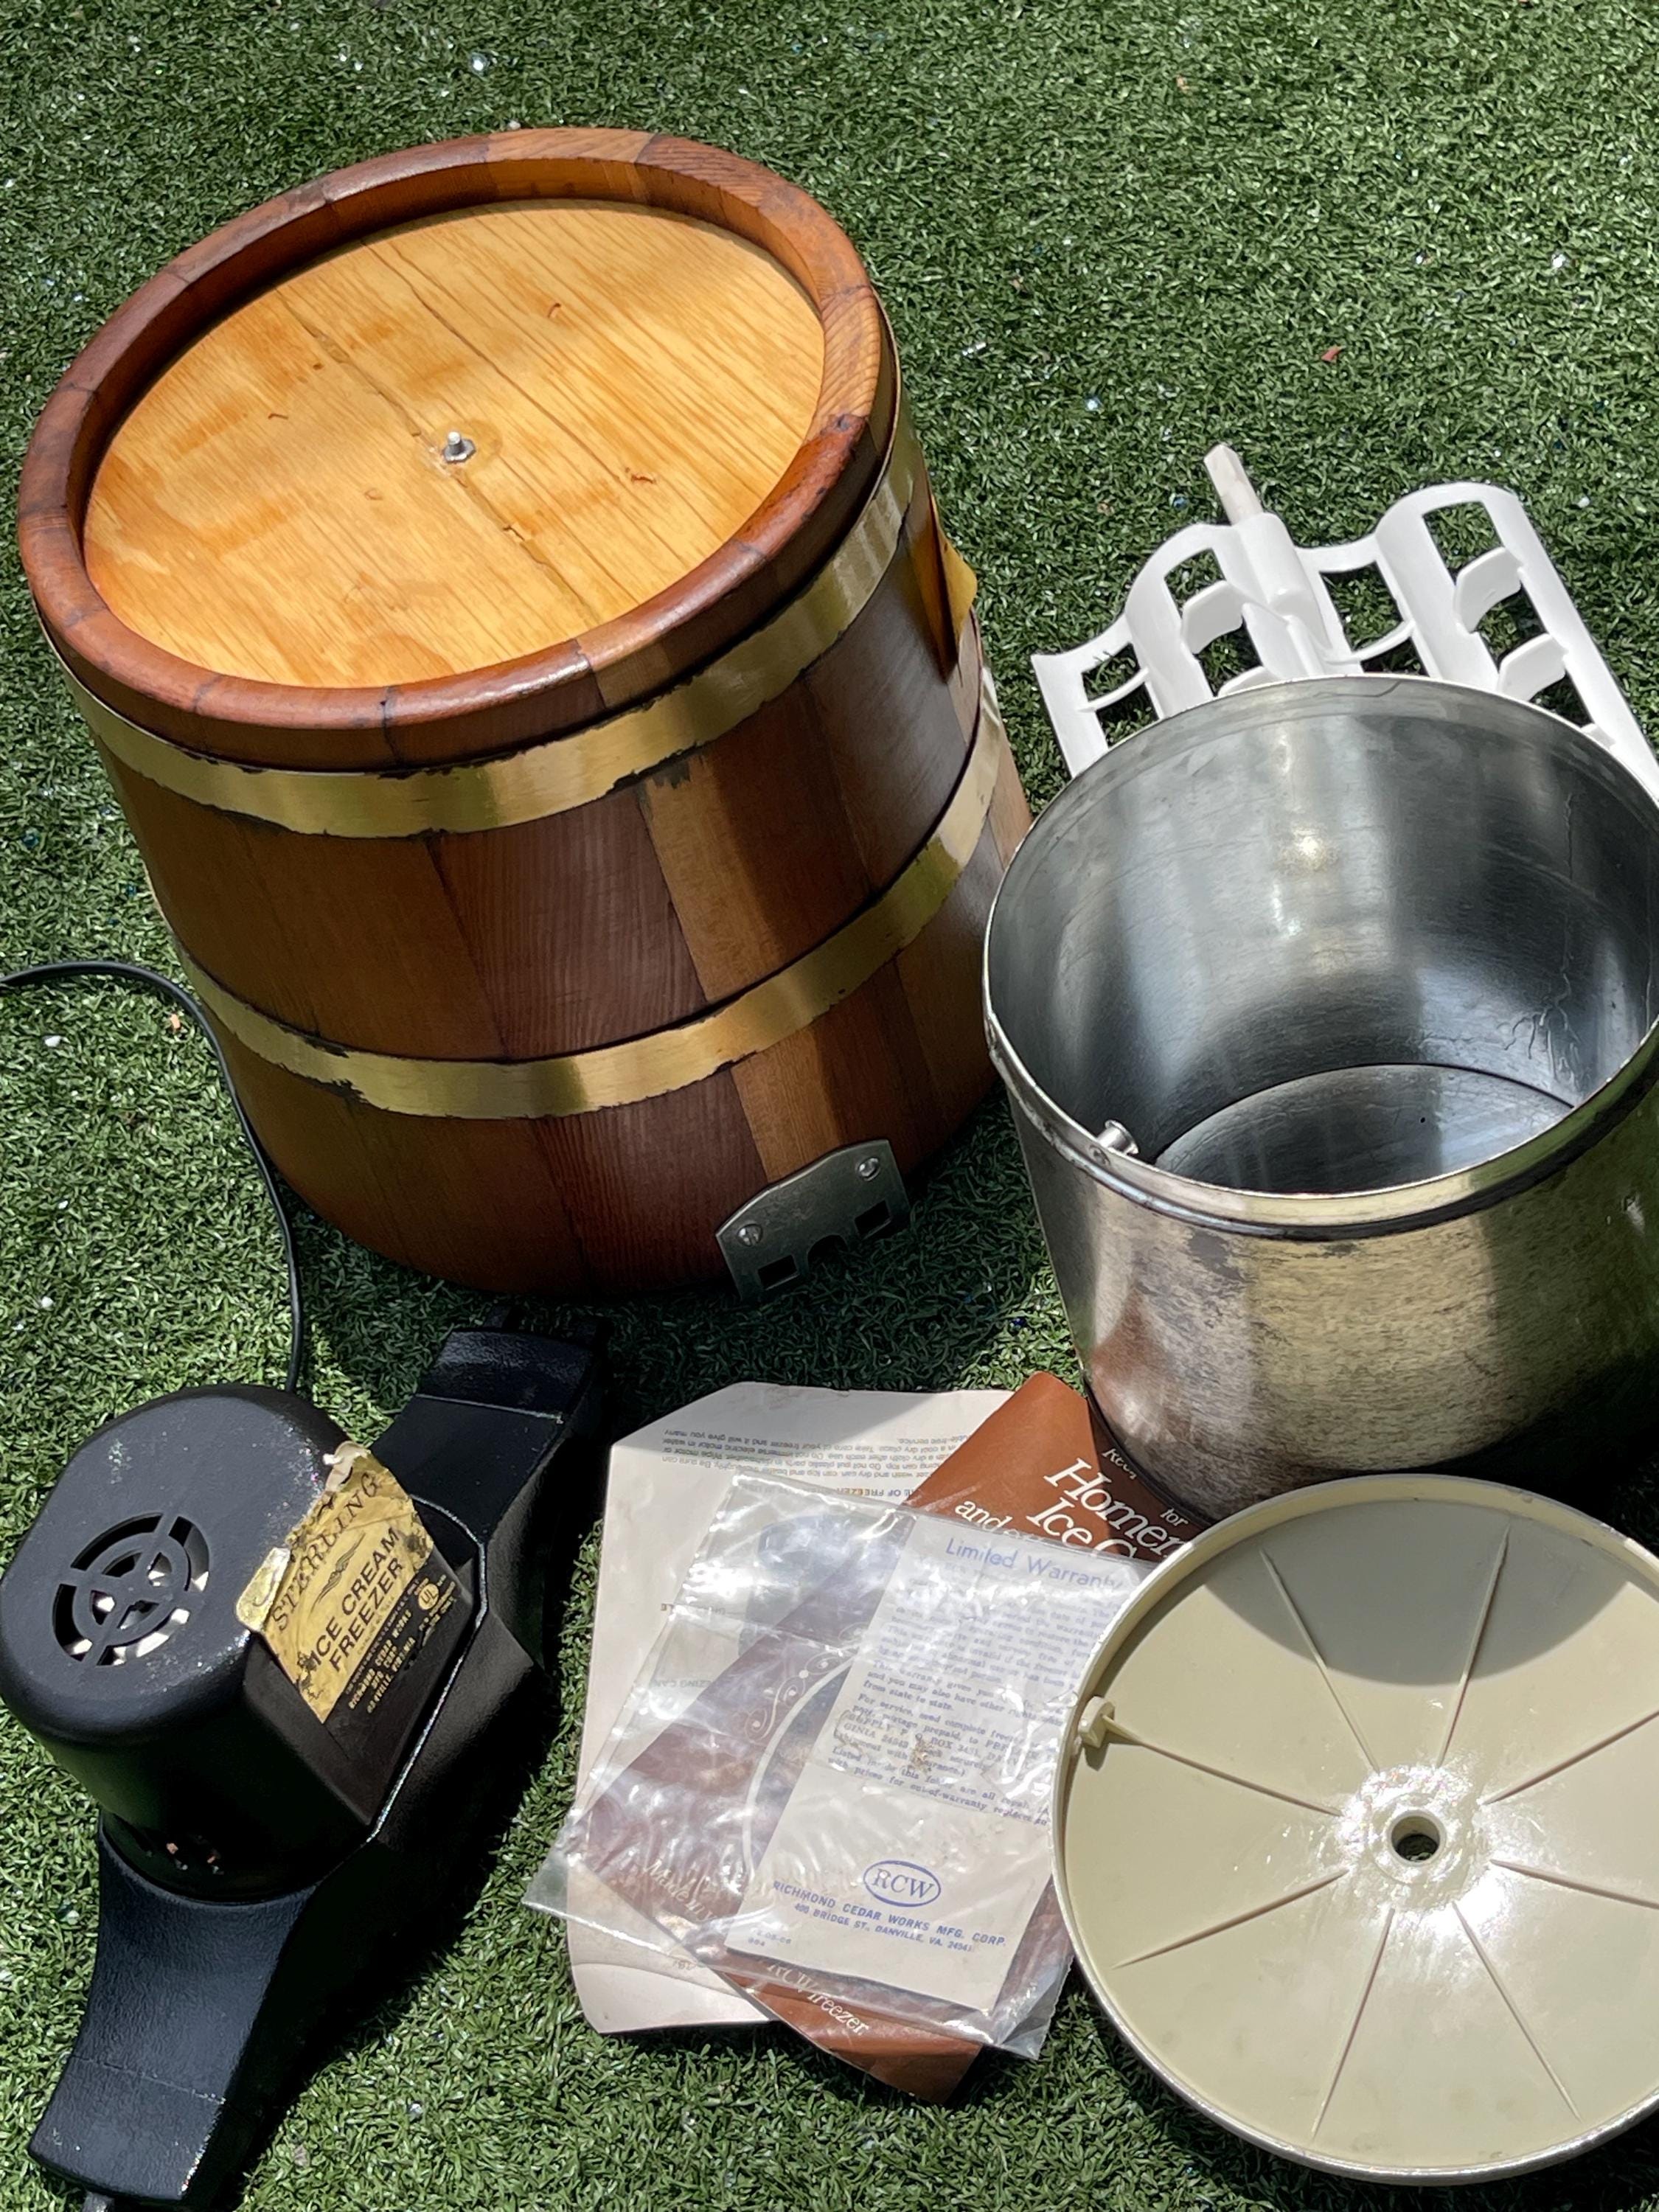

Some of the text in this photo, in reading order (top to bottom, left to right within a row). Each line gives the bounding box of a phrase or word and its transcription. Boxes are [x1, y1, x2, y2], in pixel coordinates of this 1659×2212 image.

[273, 1472, 379, 1631] STERLING
[1026, 1498, 1093, 1549] Ice
[945, 1540, 1017, 1568] Limited
[310, 1616, 342, 1665] ICE
[341, 1527, 399, 1615] CREAM
[329, 1557, 404, 1672] FREEZER
[771, 1879, 1007, 1948] RICHMOND CEDAR WORKS MFG. CORP.
[871, 1868, 935, 1902] RCW
[813, 1907, 851, 1926] BRIDGE
